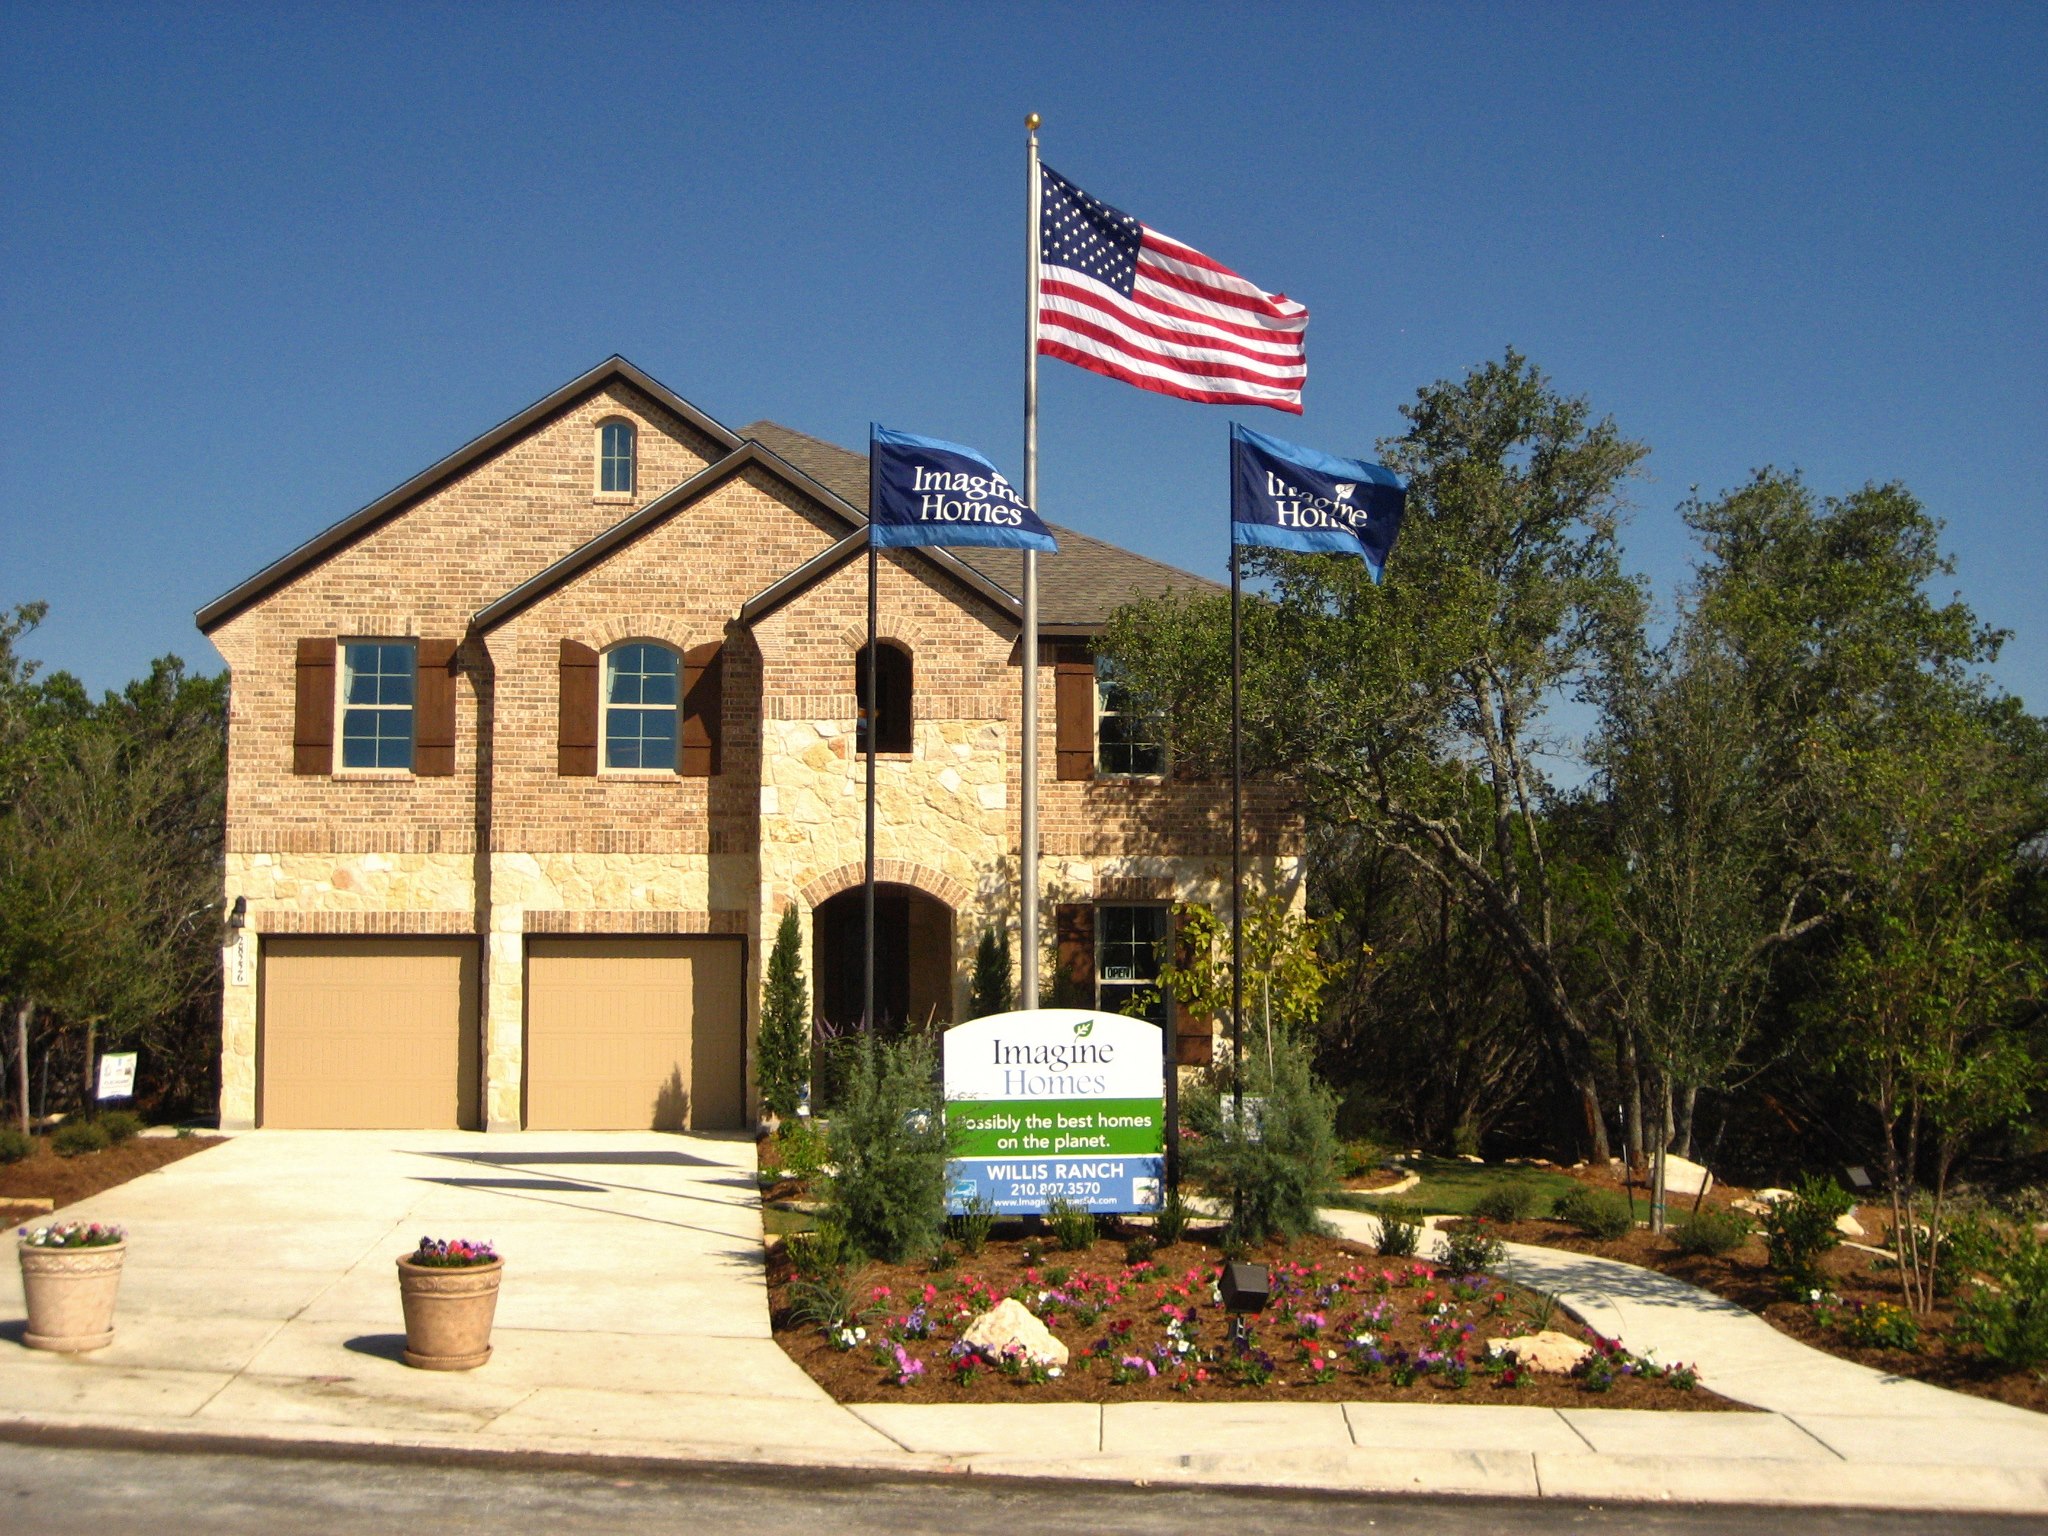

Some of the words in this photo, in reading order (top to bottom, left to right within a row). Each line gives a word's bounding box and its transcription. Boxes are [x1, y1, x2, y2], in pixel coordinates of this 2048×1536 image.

[912, 466, 1028, 508] Imagine
[920, 494, 1022, 526] Homes
[1108, 968, 1130, 978] OPEN
[993, 1039, 1114, 1072] Imagine
[1004, 1070, 1106, 1095] Homes
[962, 1113, 1021, 1134] ossibly
[1025, 1113, 1052, 1129] the
[1057, 1113, 1092, 1129] best
[1098, 1112, 1152, 1128] homes
[997, 1138, 1018, 1150] on
[1023, 1133, 1050, 1149] the
[1054, 1132, 1111, 1153] planet.
[987, 1164, 1048, 1181] WILLIS
[1055, 1163, 1124, 1179] RANCH
[1011, 1181, 1101, 1197] 210.807.3570
